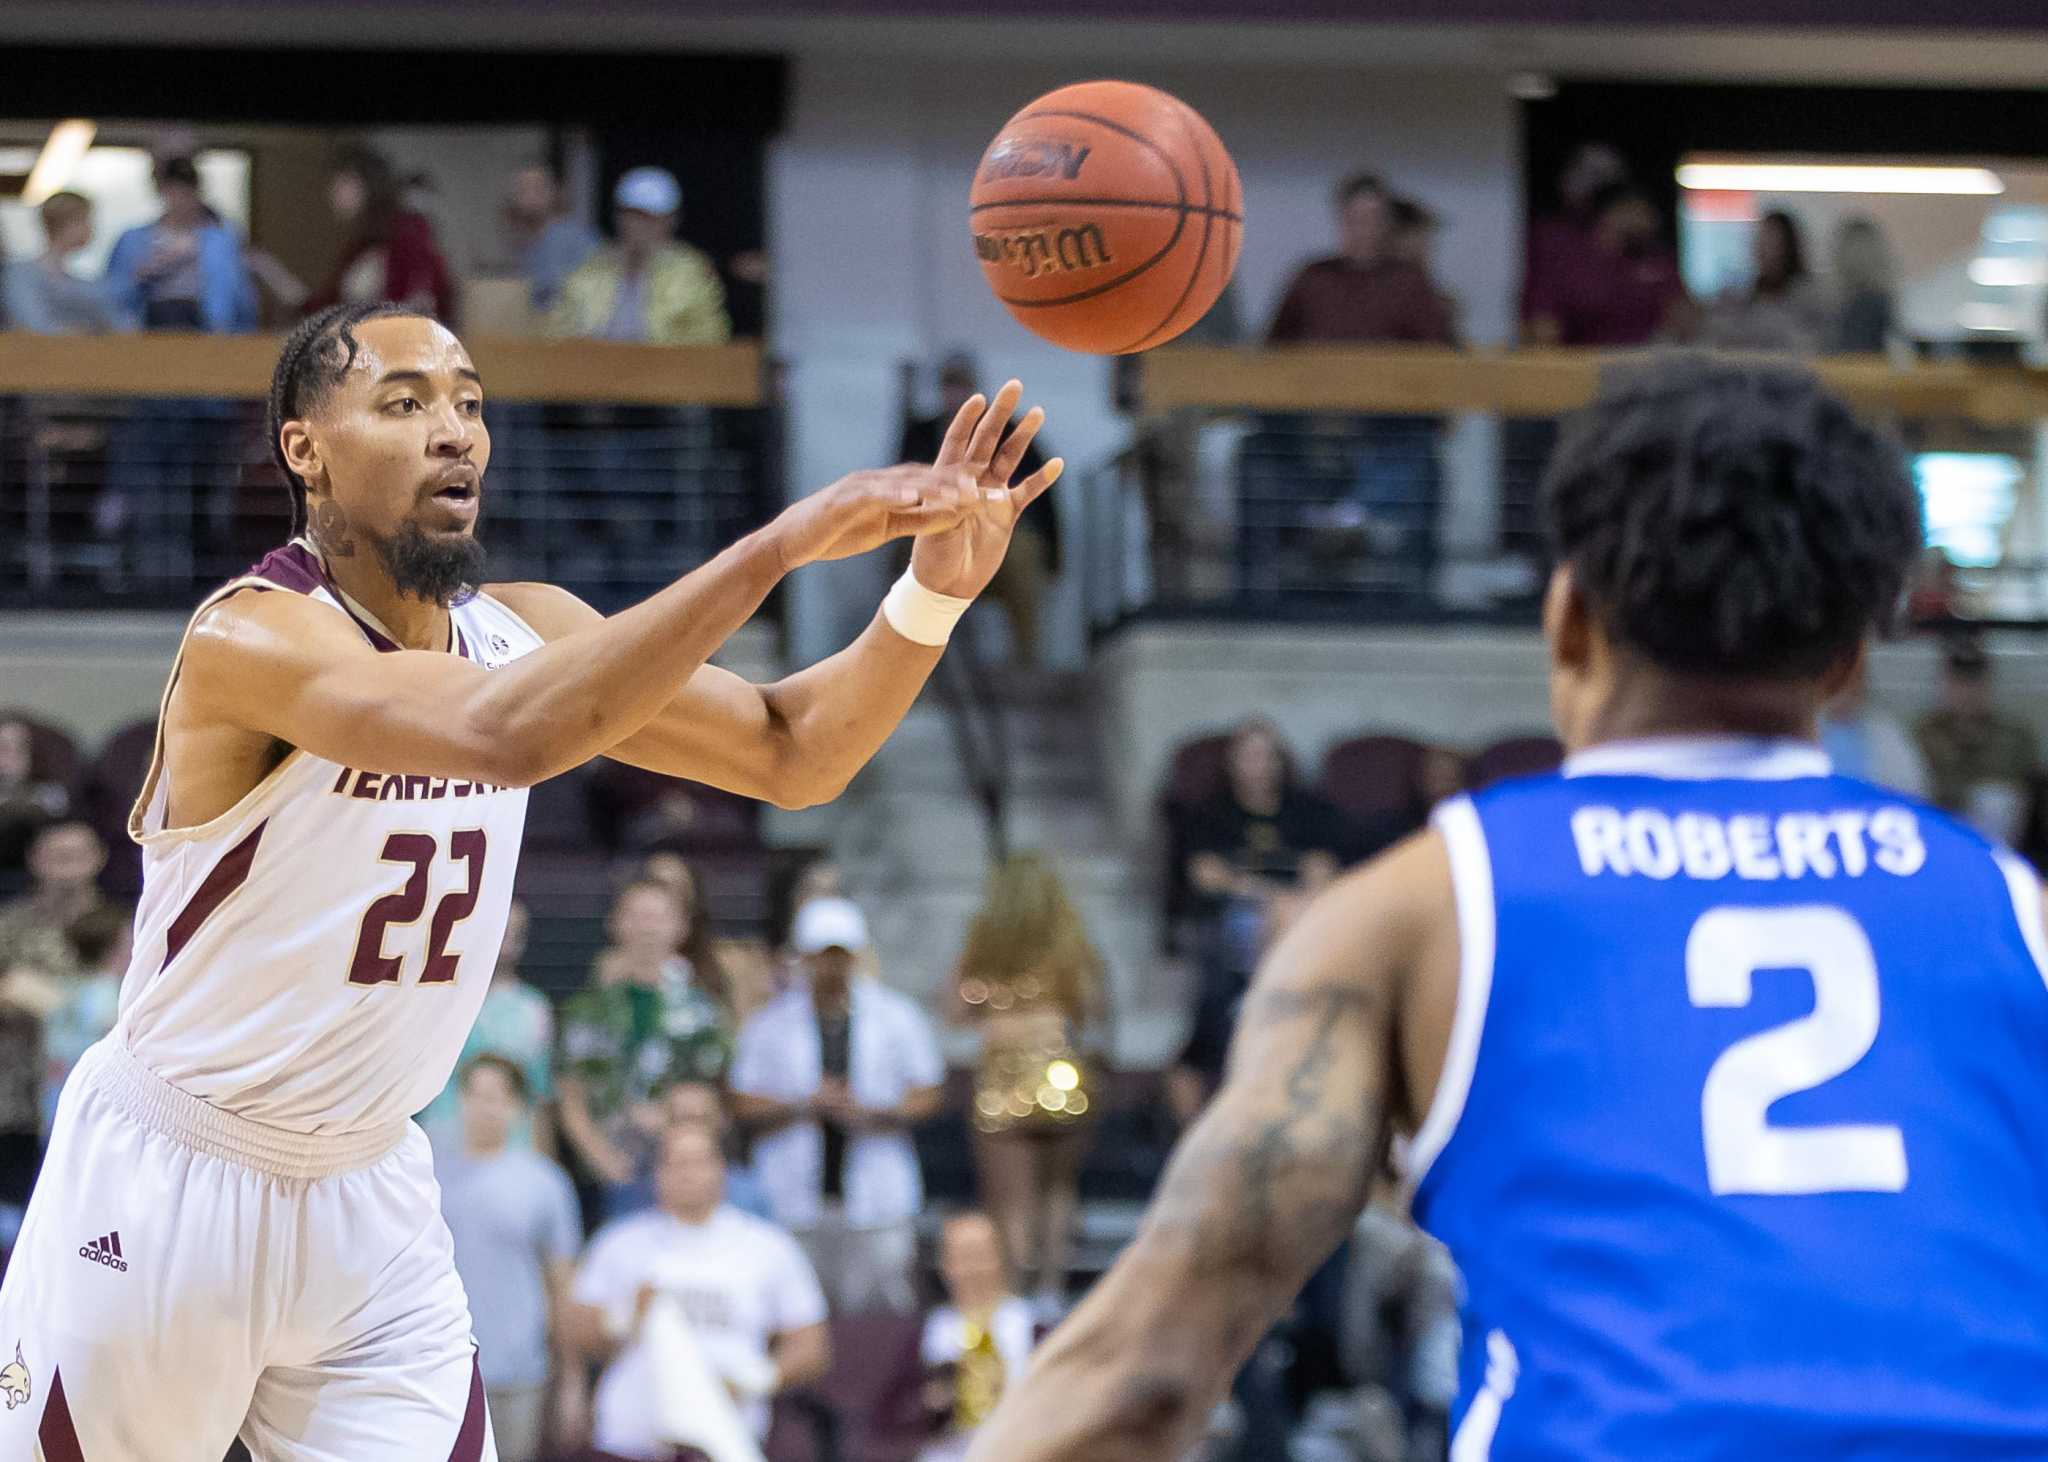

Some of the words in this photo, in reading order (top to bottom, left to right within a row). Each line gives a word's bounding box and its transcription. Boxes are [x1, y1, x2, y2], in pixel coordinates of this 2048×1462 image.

[1570, 805, 1926, 880] ROBERTS
[346, 825, 487, 986] 22
[1685, 905, 1909, 1196] 2
[79, 1246, 128, 1272] adidas
